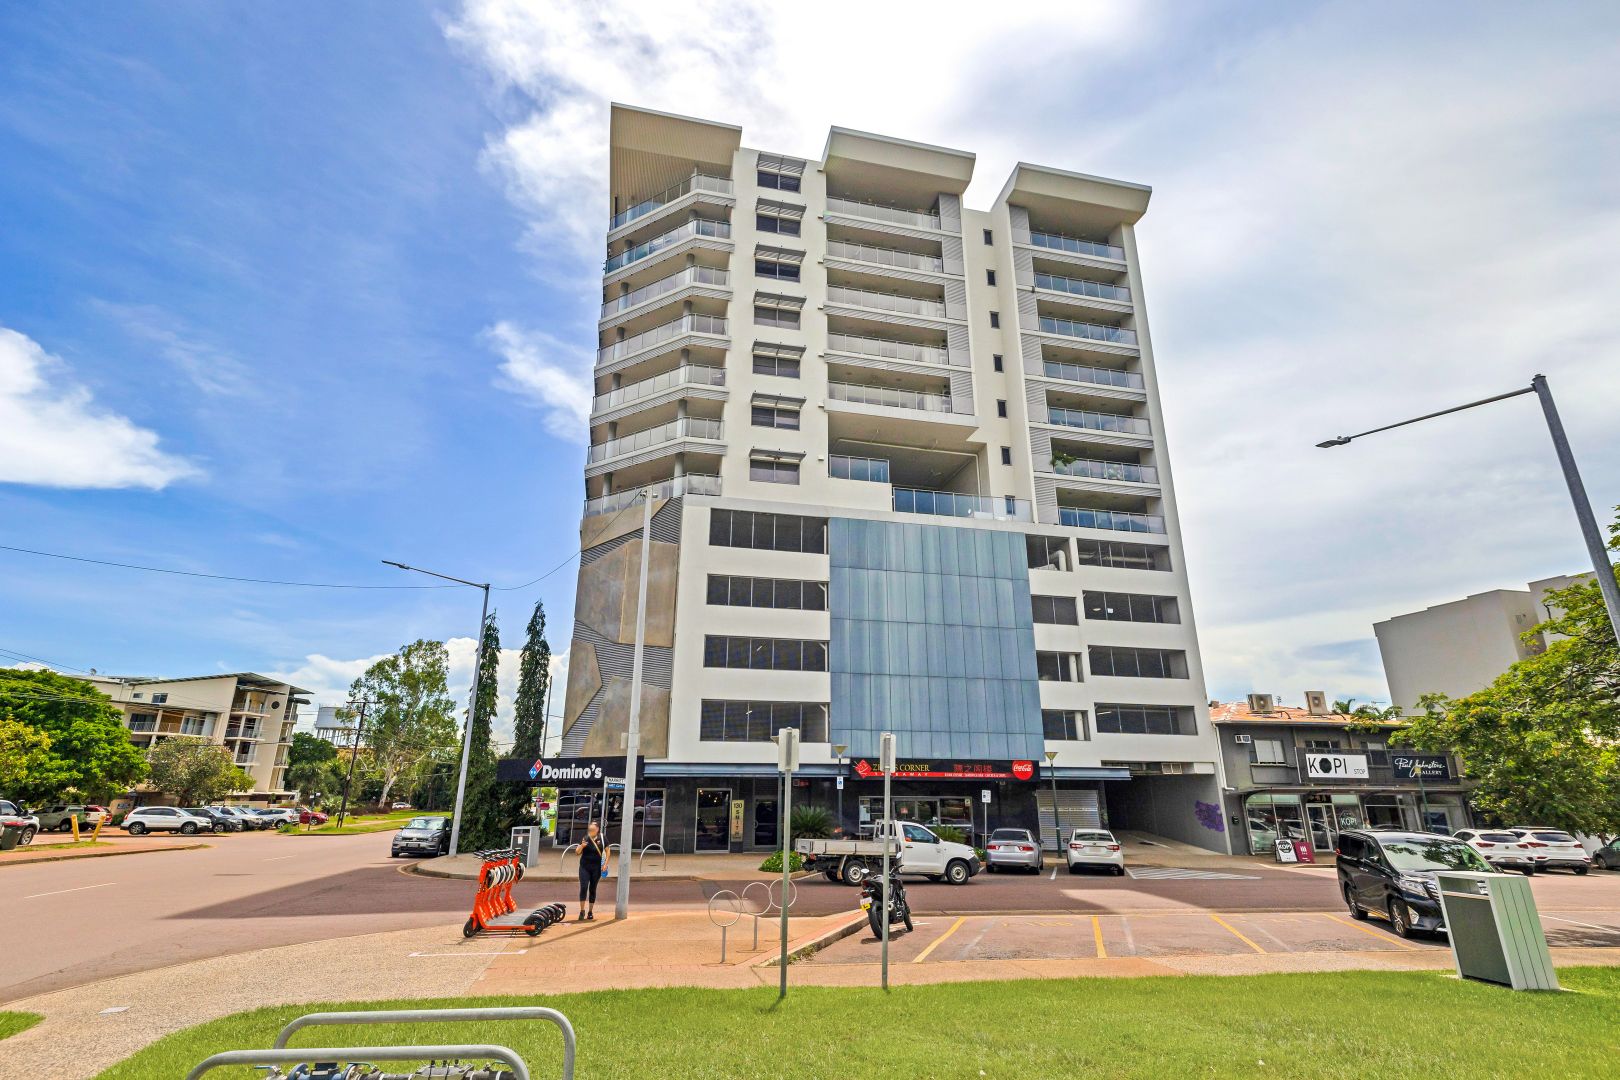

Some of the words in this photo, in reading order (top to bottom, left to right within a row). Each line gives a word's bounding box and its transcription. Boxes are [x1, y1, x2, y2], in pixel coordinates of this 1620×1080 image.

[1395, 758, 1412, 769] Paul
[542, 764, 602, 779] Domino's
[1341, 818, 1357, 826] KOPI
